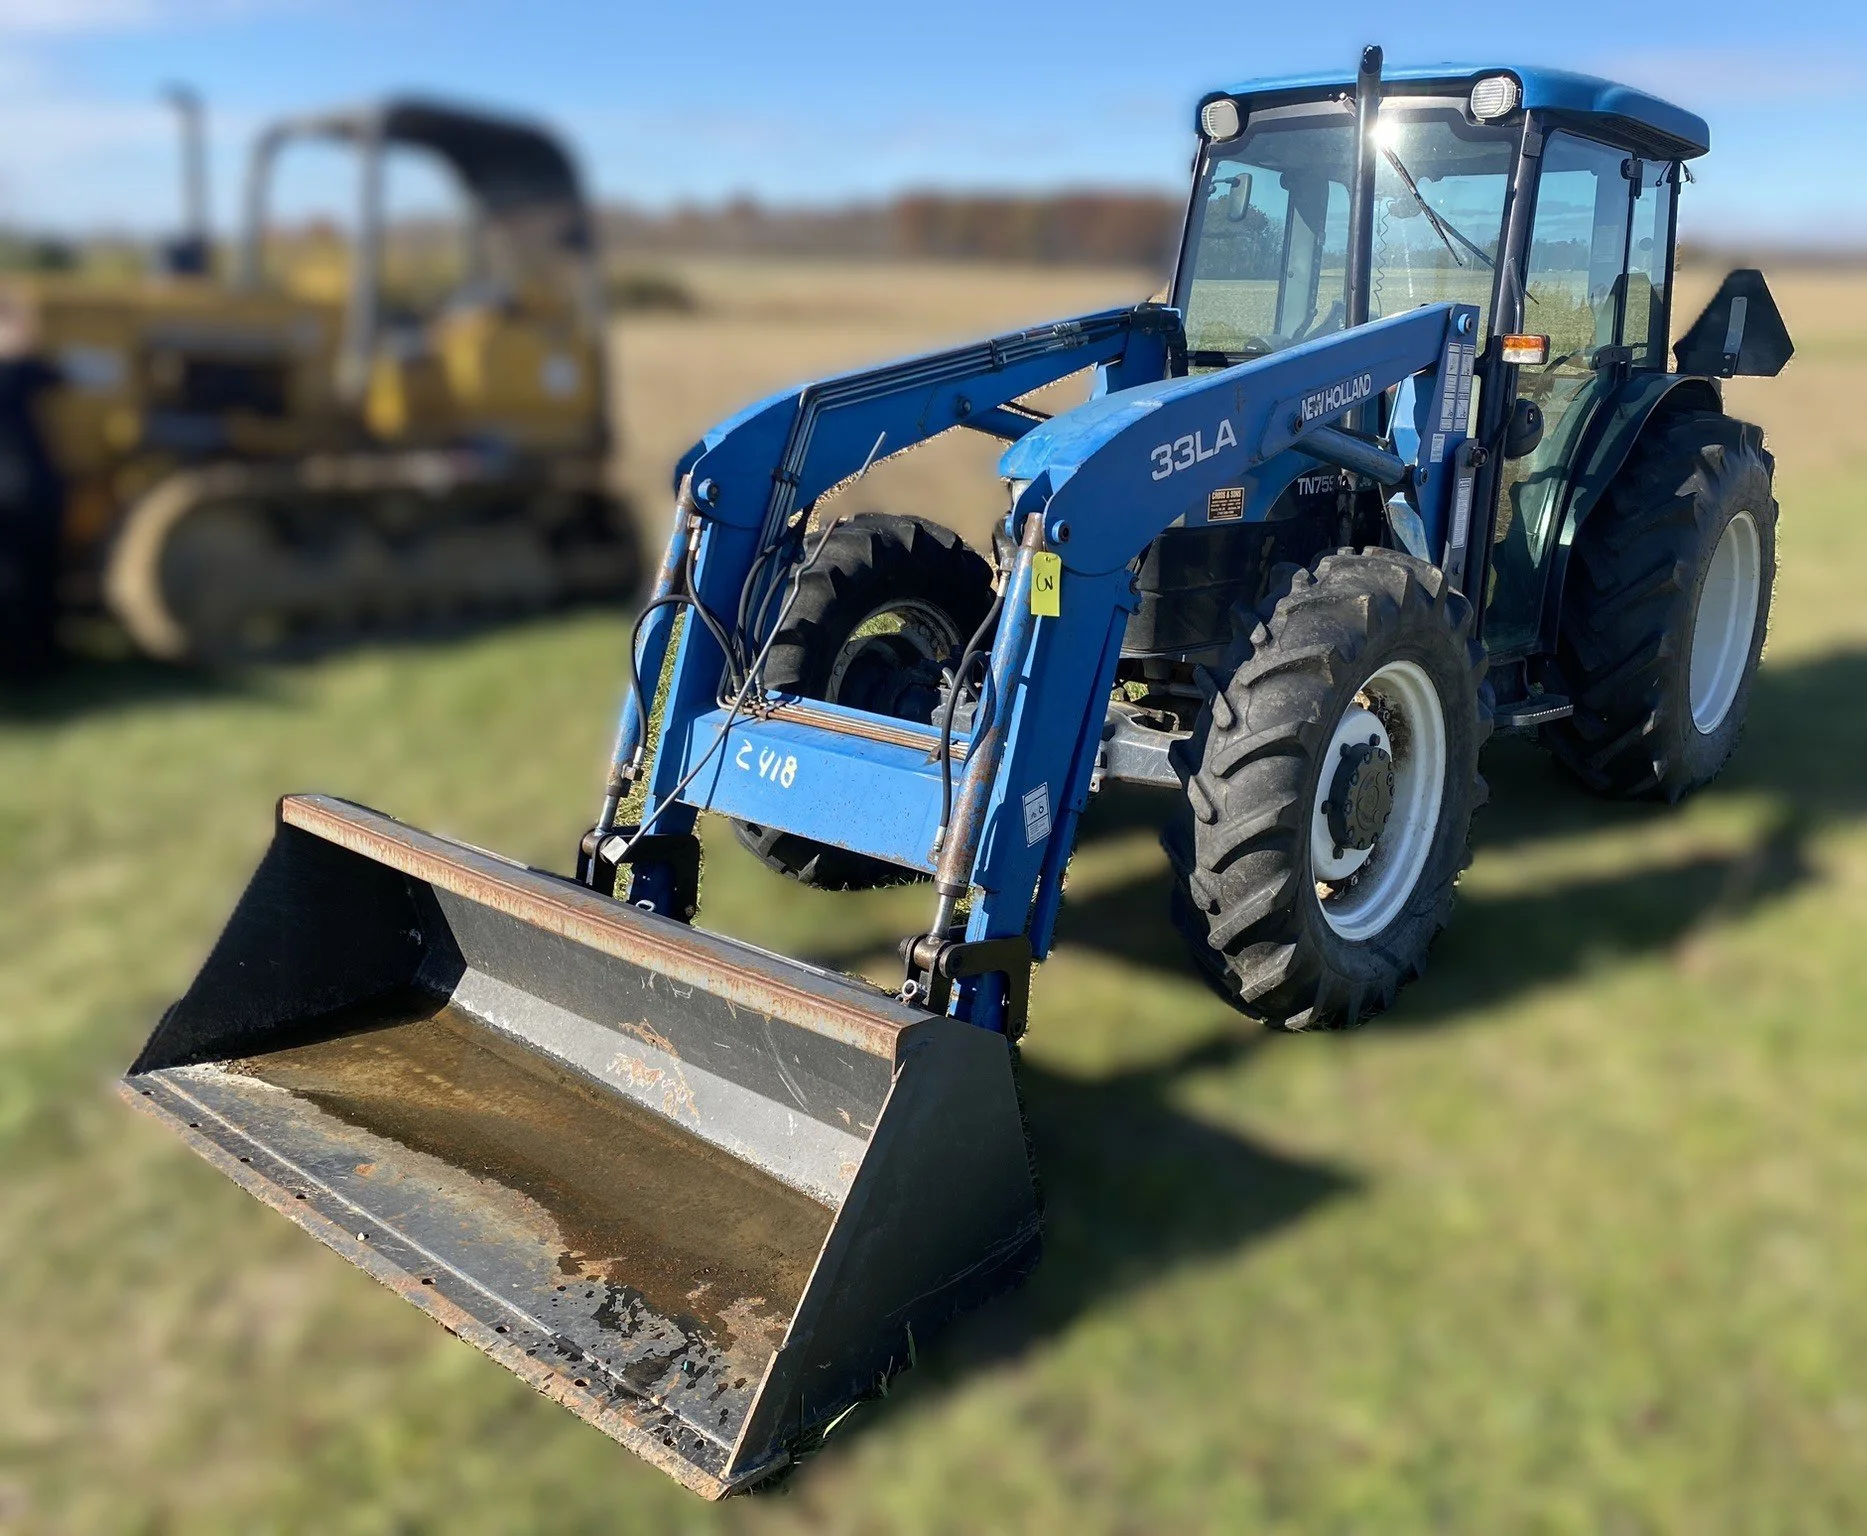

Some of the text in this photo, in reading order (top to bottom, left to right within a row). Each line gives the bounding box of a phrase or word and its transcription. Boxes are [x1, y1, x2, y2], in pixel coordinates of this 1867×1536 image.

[1301, 374, 1372, 421] NEW HOLLAND
[1150, 419, 1238, 481] 33LA
[736, 739, 798, 789] 2418
